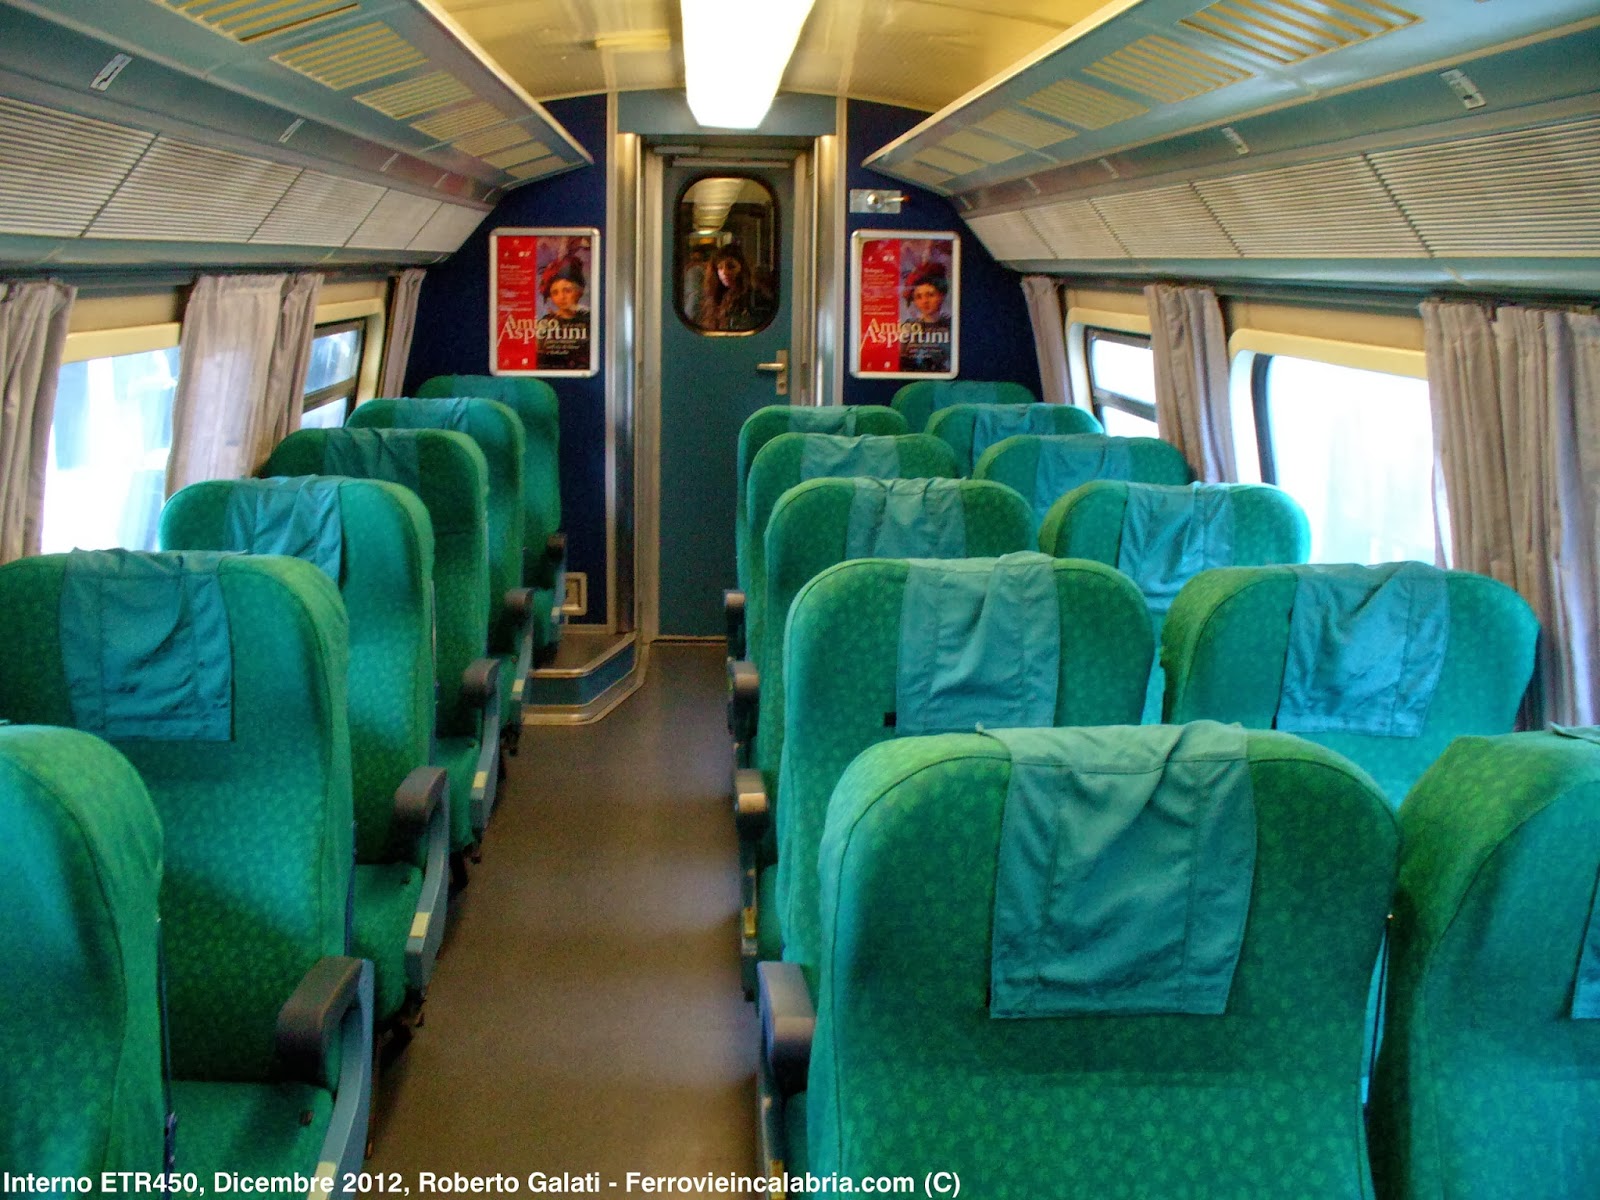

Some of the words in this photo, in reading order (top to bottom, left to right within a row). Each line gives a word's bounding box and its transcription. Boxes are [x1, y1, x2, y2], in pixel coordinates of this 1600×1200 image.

[506, 313, 560, 330] Amico
[869, 317, 922, 334] Amico
[497, 320, 588, 346] Aspertini
[861, 325, 950, 349] Aspertini
